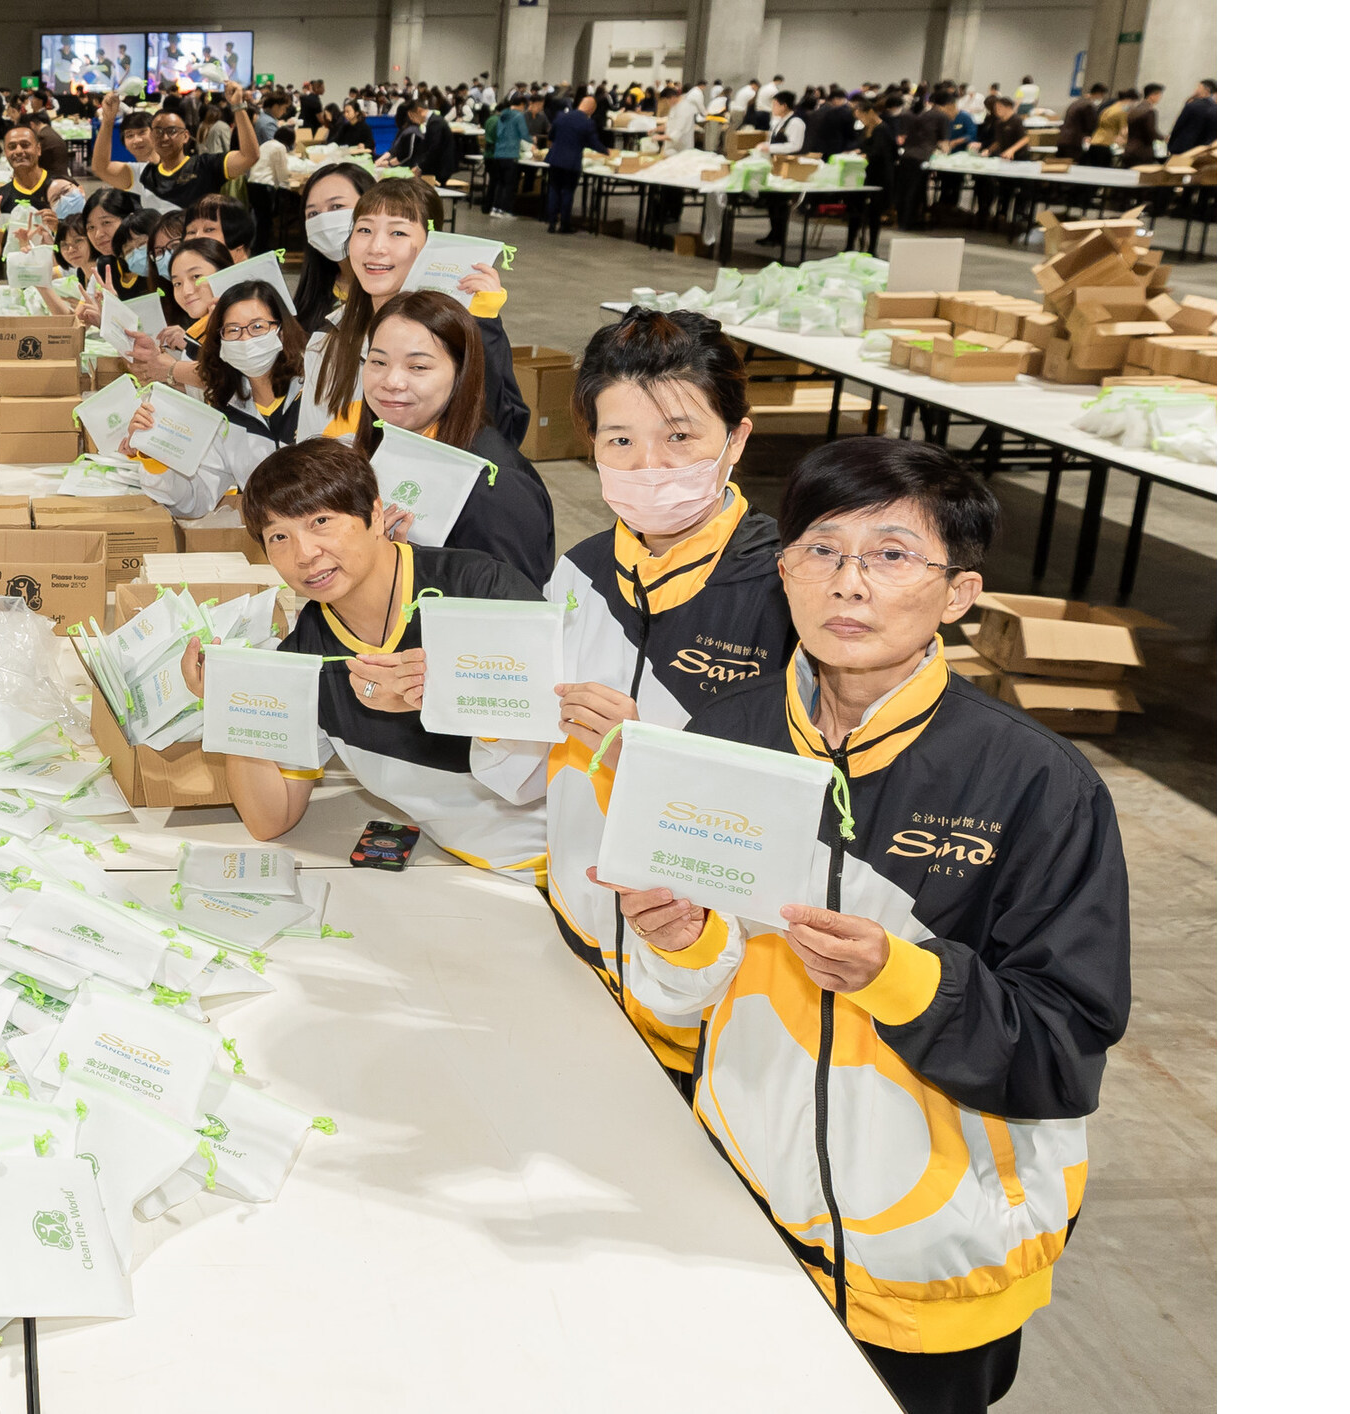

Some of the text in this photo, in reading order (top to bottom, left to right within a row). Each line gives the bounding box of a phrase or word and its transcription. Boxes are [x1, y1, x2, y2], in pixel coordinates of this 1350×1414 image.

[121, 558, 144, 569] SO
[73, 573, 89, 581] keep
[455, 654, 528, 672] Sands
[455, 671, 529, 682] SANDS CARES
[229, 692, 287, 710] Sands
[456, 695, 530, 709] 金沙環保360
[228, 706, 289, 719] SANDS CARES
[457, 708, 489, 716] SANDS
[228, 726, 288, 741] 金沙環保360
[659, 801, 765, 838] Sands
[658, 820, 763, 851] SANDS CARES
[223, 853, 238, 879] Sands
[649, 865, 693, 882] SANDS
[651, 850, 755, 885] 金沙環保360
[94, 1040, 171, 1076] SANDS CARES
[97, 1032, 174, 1068] Sands
[82, 1066, 117, 1083] SANDS
[86, 1057, 164, 1094] 金沙環保360
[74, 1221, 87, 1238] the
[80, 1240, 94, 1270] Clean
